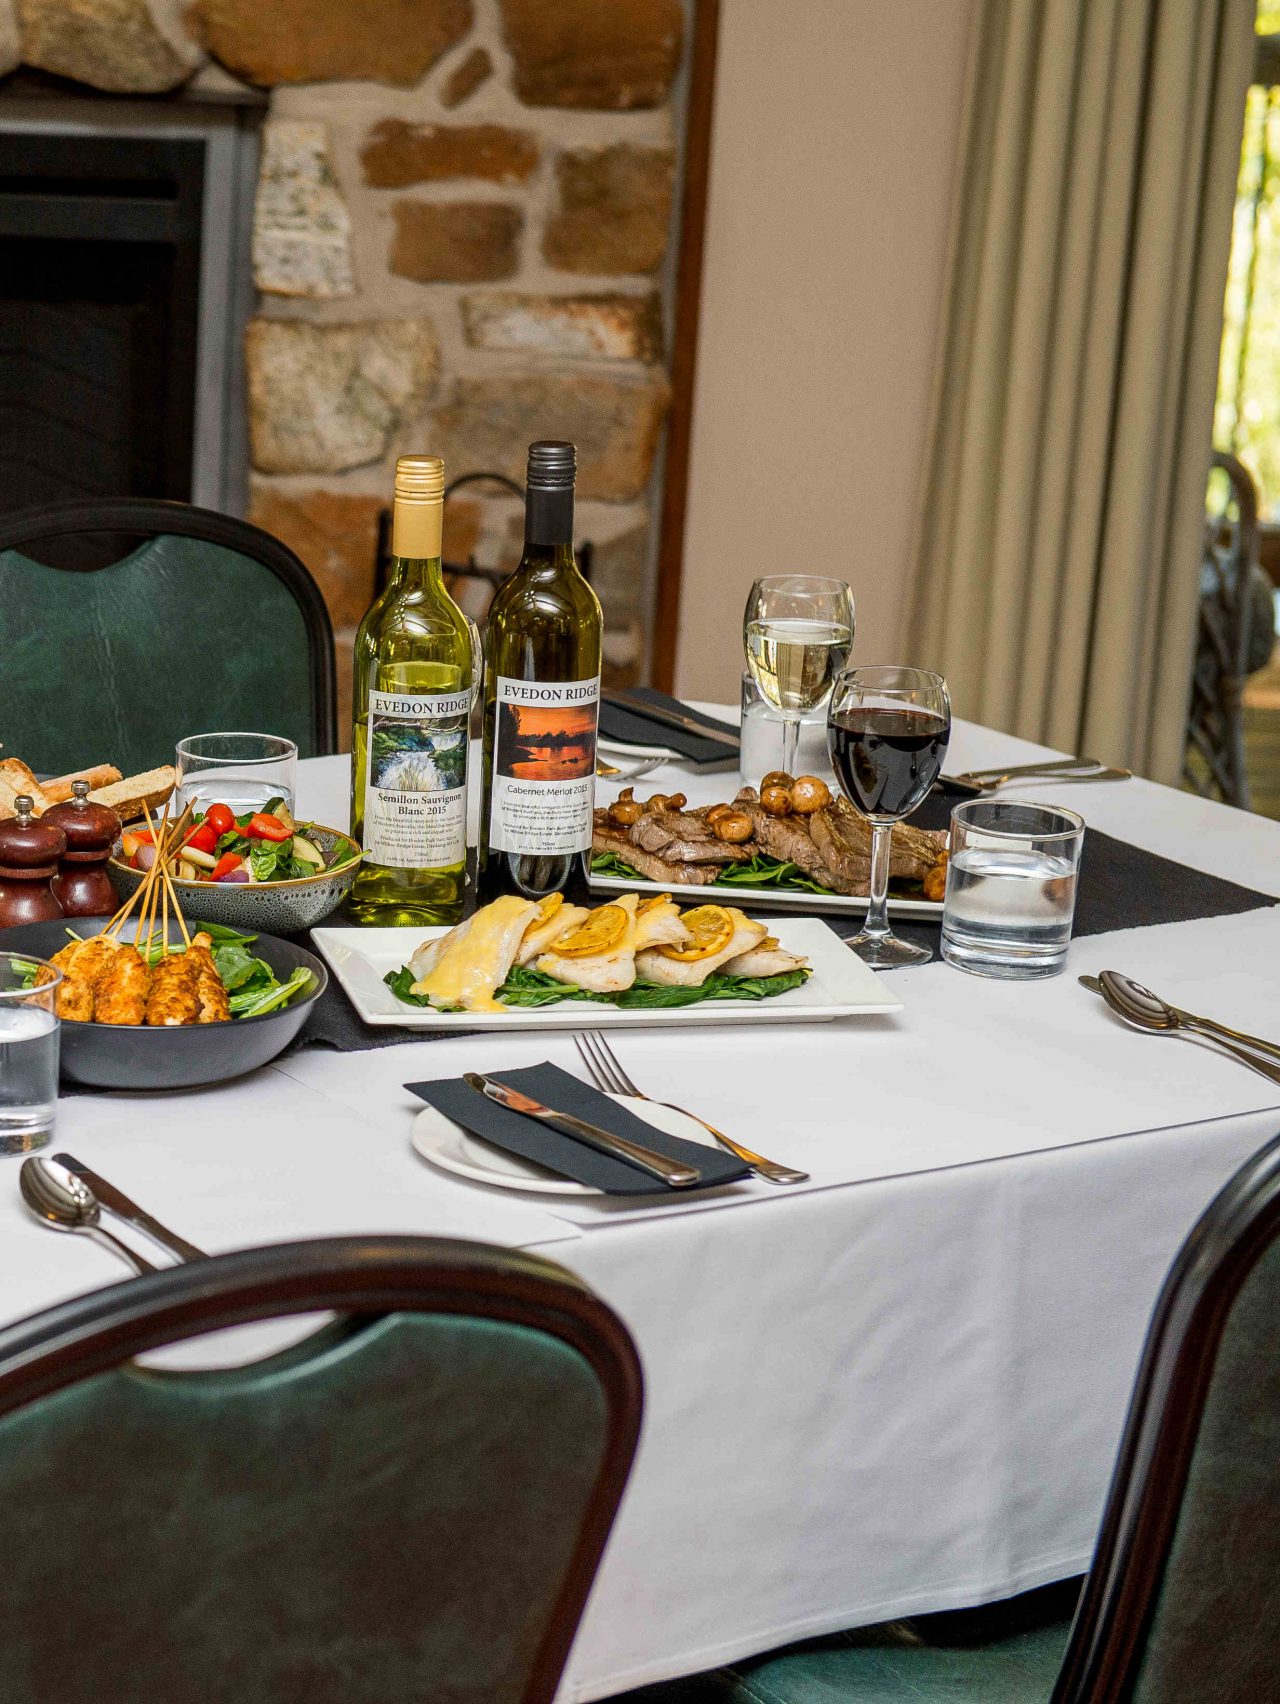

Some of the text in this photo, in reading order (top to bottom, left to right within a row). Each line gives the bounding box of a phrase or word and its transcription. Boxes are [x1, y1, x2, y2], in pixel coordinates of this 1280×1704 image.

[504, 684, 598, 700] EVEDON RIDGE
[375, 698, 469, 714] EVEDON RIDGE
[507, 785, 545, 796] Cabernet
[546, 788, 572, 796] Merlot
[378, 793, 462, 805] Semillon Sauvignon
[398, 806, 447, 815] Blanc 2015
